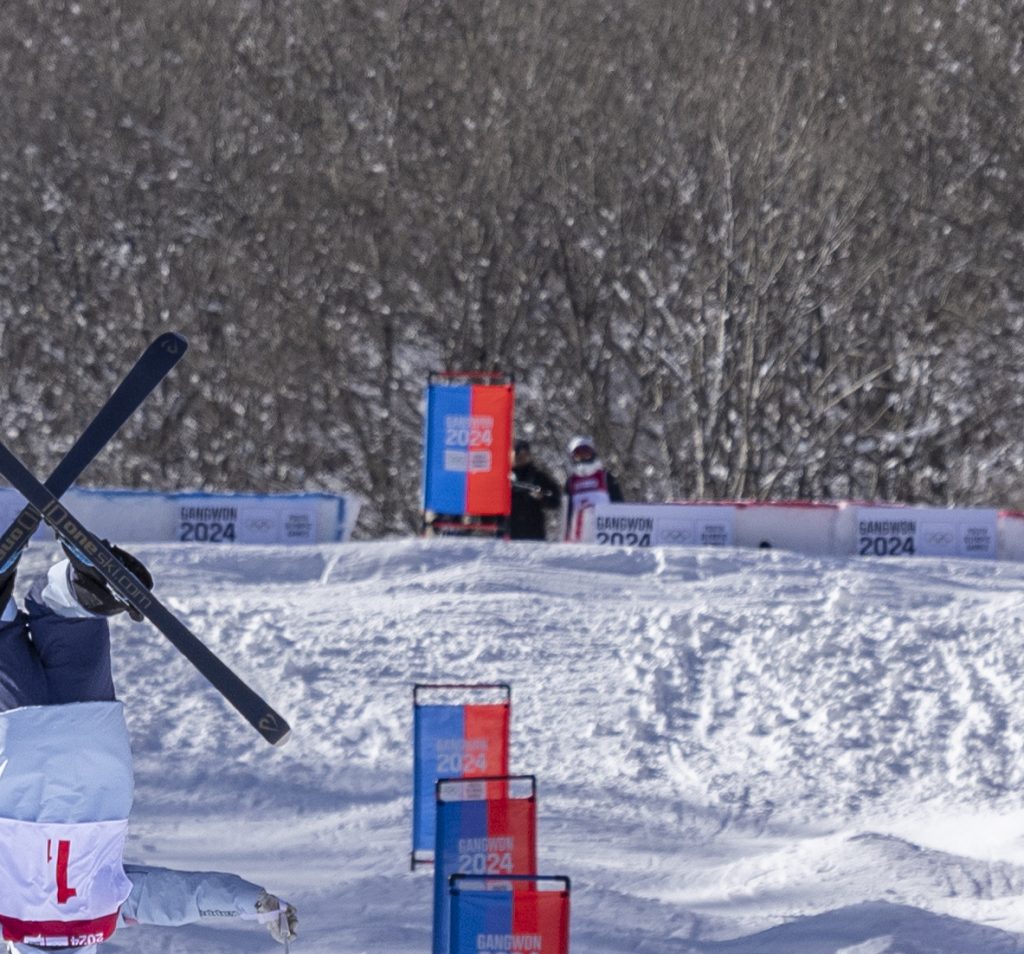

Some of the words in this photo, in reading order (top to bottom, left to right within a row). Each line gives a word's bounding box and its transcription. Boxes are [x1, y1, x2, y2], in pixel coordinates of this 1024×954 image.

[180, 522, 236, 542] 2024
[860, 537, 916, 556] 2024
[437, 754, 487, 772] 2024
[459, 854, 513, 874] 2024
[477, 934, 542, 950] GANGWON
